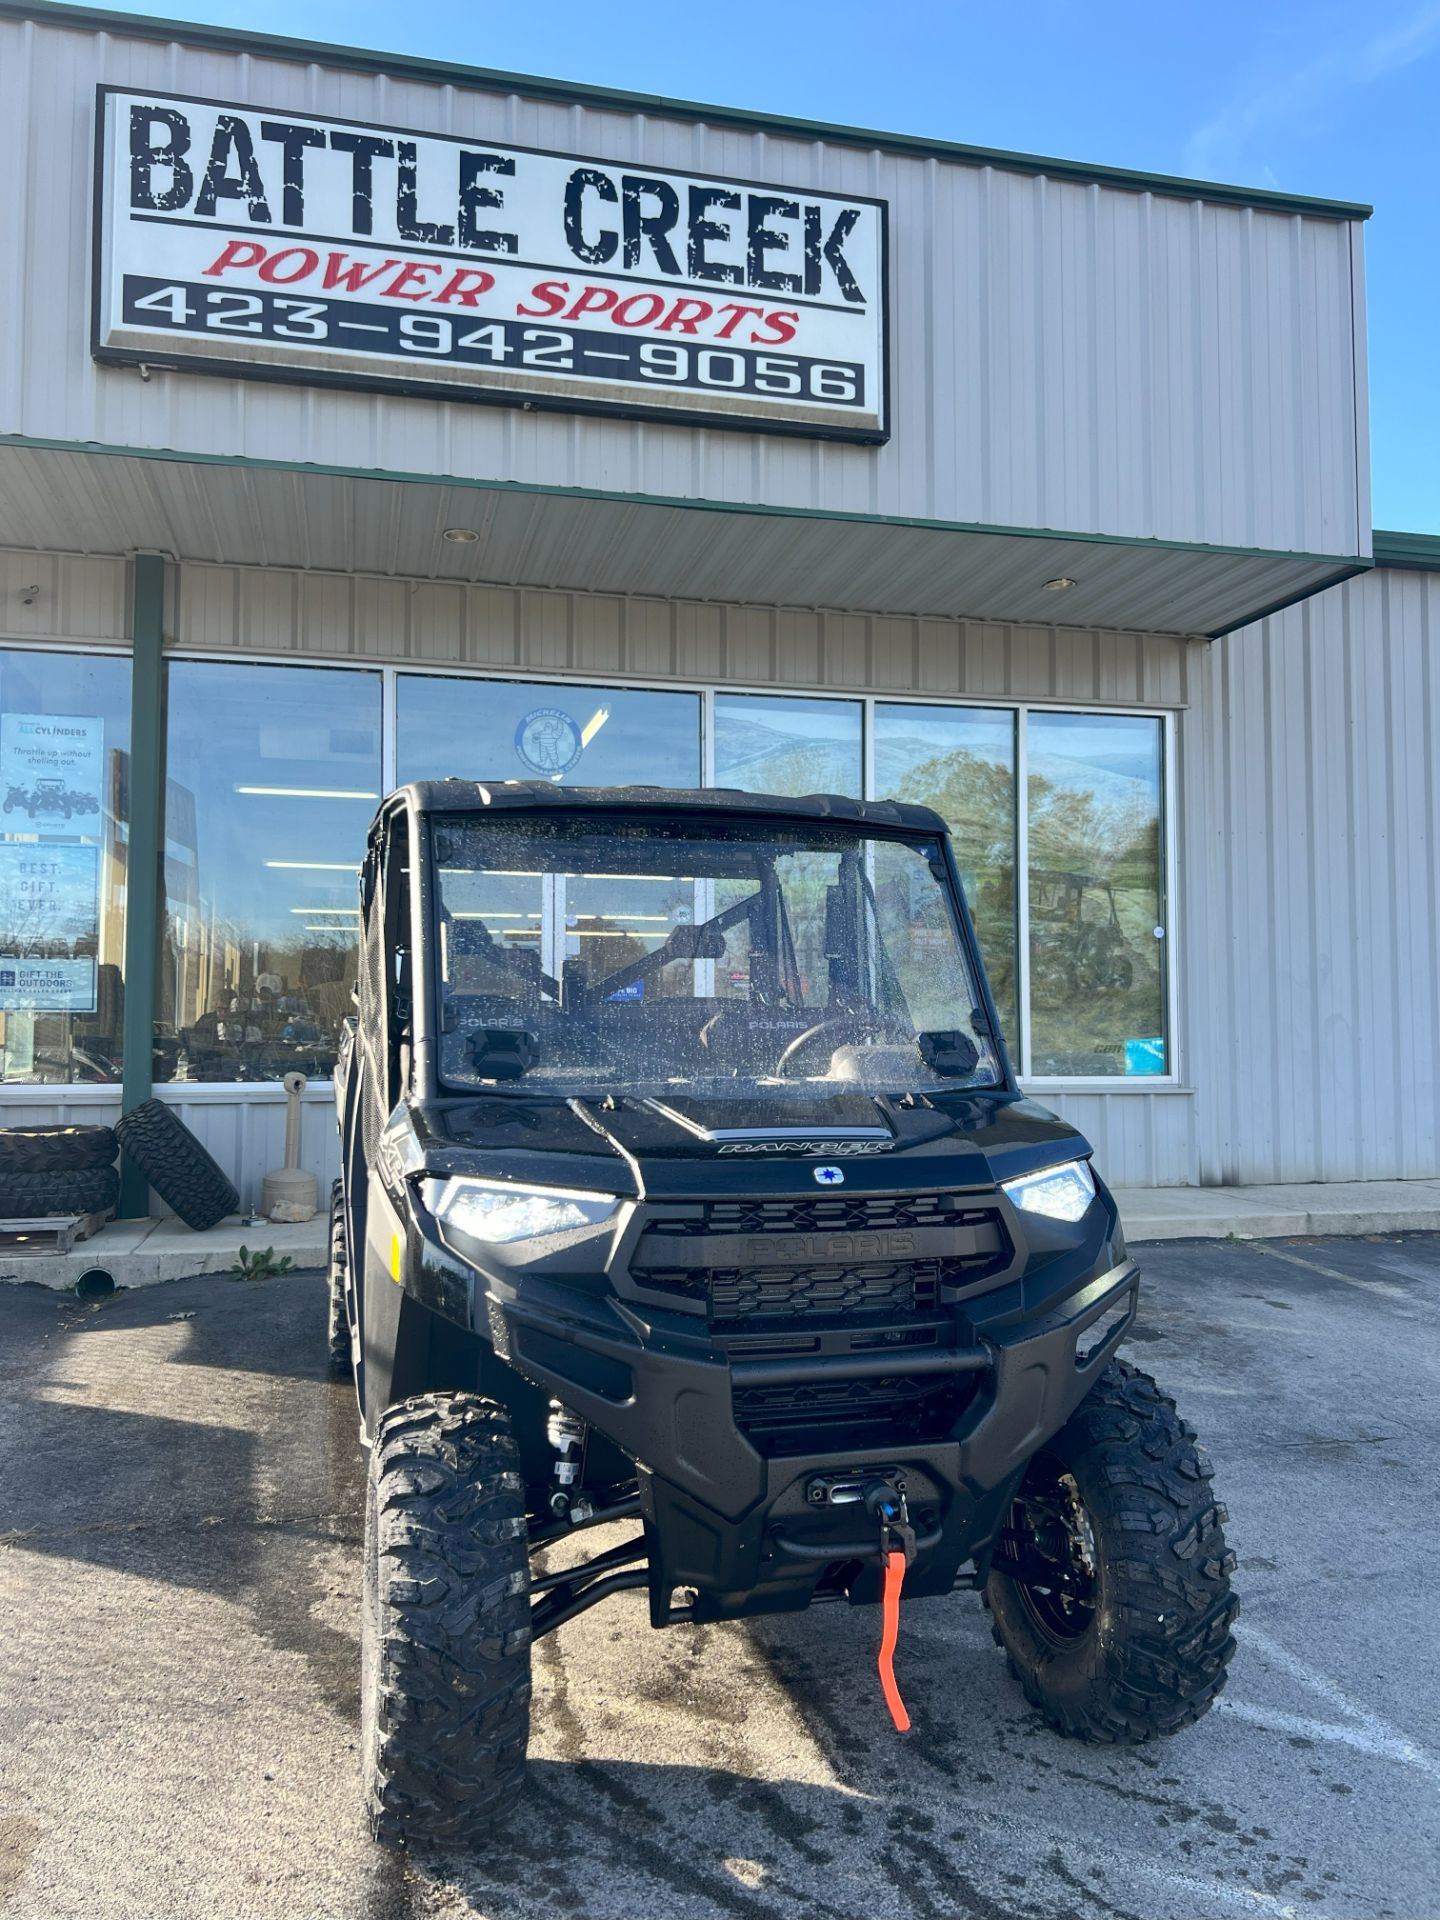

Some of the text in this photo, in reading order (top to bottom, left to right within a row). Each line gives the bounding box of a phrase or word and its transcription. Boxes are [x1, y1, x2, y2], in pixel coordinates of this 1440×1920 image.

[130, 104, 867, 303] BATTLE CREEK
[202, 240, 800, 345] POWER SPORTS
[133, 286, 856, 401] 423-942-9056
[525, 708, 574, 725] MICHELIN
[14, 747, 91, 758] Throttle up without
[20, 863, 61, 875] BEST.
[20, 881, 60, 893] GIFT.
[18, 900, 61, 912] EVER.
[20, 970, 64, 979] GIFT THE
[20, 979, 73, 987] OUTDOORS
[460, 1018, 523, 1027] POLARIS
[749, 1020, 809, 1030] POLARIS
[718, 1141, 895, 1153] RANGER
[747, 1232, 916, 1261] POLARIS
